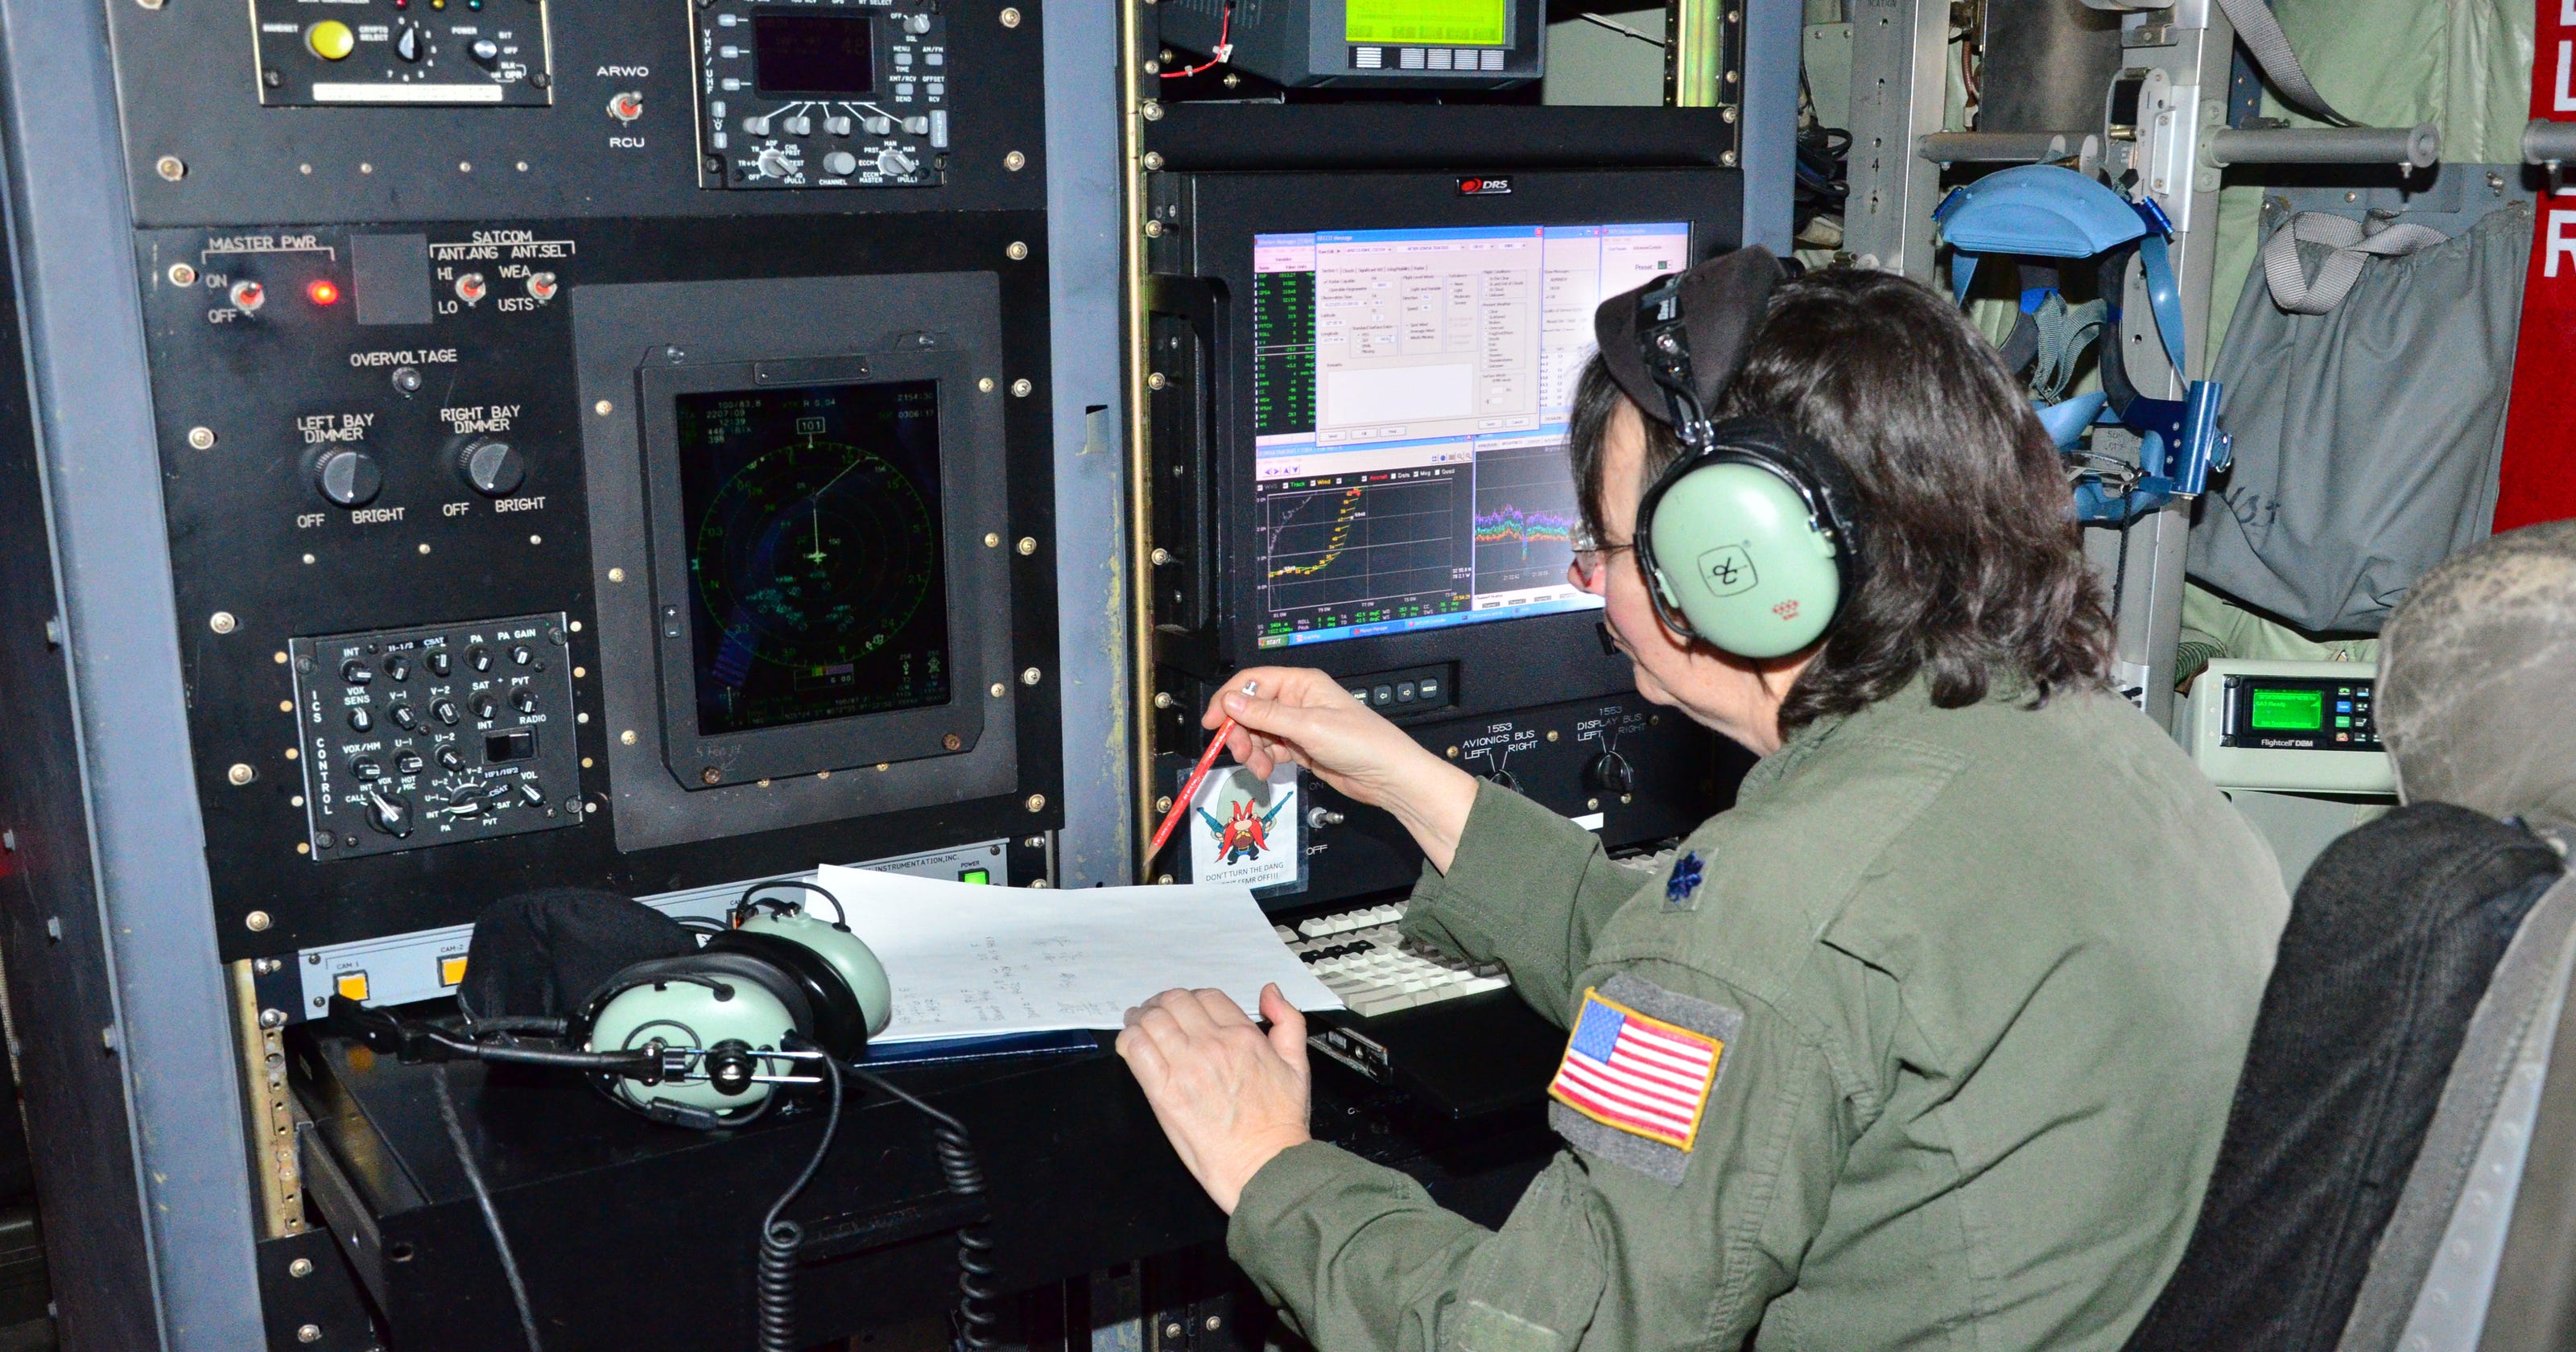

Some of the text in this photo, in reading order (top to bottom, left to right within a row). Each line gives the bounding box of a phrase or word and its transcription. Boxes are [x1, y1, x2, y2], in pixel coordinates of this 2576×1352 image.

[451, 27, 477, 35] POWER
[498, 31, 513, 39] BIT
[503, 47, 518, 55] OFF
[597, 66, 650, 76] ARWO
[609, 138, 645, 147] RCU
[1483, 180, 1508, 189] DRS
[208, 235, 317, 250] MASTER PWR
[472, 230, 533, 245] SATCOM
[438, 245, 567, 261] ANT.ANG ANT.SEL
[437, 265, 531, 280] HI WEA
[205, 274, 228, 288] ON
[438, 298, 534, 314] LO USTS
[208, 309, 237, 323] OFF
[349, 348, 457, 367] OVERVOLTAGE
[440, 405, 521, 422] RIGHT BAY
[297, 414, 374, 431] LEFT BAY
[454, 419, 510, 435] DIMMER
[802, 421, 821, 431] 101
[304, 427, 364, 443] DIMMER
[443, 497, 545, 517] OFF BRIGHT
[297, 507, 405, 528] OFF BRIGHT
[470, 634, 483, 643] PA
[497, 629, 536, 641] PA GAIN
[343, 647, 360, 657] INT
[473, 681, 489, 690] SAT
[511, 676, 530, 686] PVT
[347, 686, 365, 695] VOX
[390, 690, 407, 700] V-1
[430, 686, 451, 695] V-2
[345, 695, 370, 706] SENS
[1599, 707, 1622, 716] 1553
[519, 714, 547, 724] RADIO
[1577, 714, 1642, 731] DISPLAY BUS
[477, 720, 493, 730] INT
[1488, 723, 1512, 733] 1553
[435, 732, 456, 743] U-2
[1577, 723, 1646, 742] LEFT RIGHT
[394, 738, 412, 748] U-1
[1463, 730, 1535, 748] AVIONICS BUS
[2261, 739, 2293, 748] Flightcell
[342, 741, 381, 754] VOX/HM
[1464, 740, 1538, 760] LEFT RIGHT
[467, 767, 482, 775] V-2
[520, 771, 539, 780] VOL
[401, 776, 416, 784] HOT
[489, 784, 509, 798] CSAT
[1309, 782, 1324, 791] ON
[345, 794, 366, 802] CALL
[424, 794, 440, 802] U-1
[497, 801, 511, 810] SAT
[426, 810, 440, 818] INT
[483, 818, 497, 826] PVT
[1306, 844, 1328, 856] OFF
[875, 854, 960, 872] INSTRUMENTATION,INC.
[1205, 871, 1228, 883] DON'T
[1229, 868, 1248, 877] TURN
[1250, 867, 1263, 875] THE
[1264, 862, 1284, 872] DANG
[1257, 873, 1278, 881] OFF!!!
